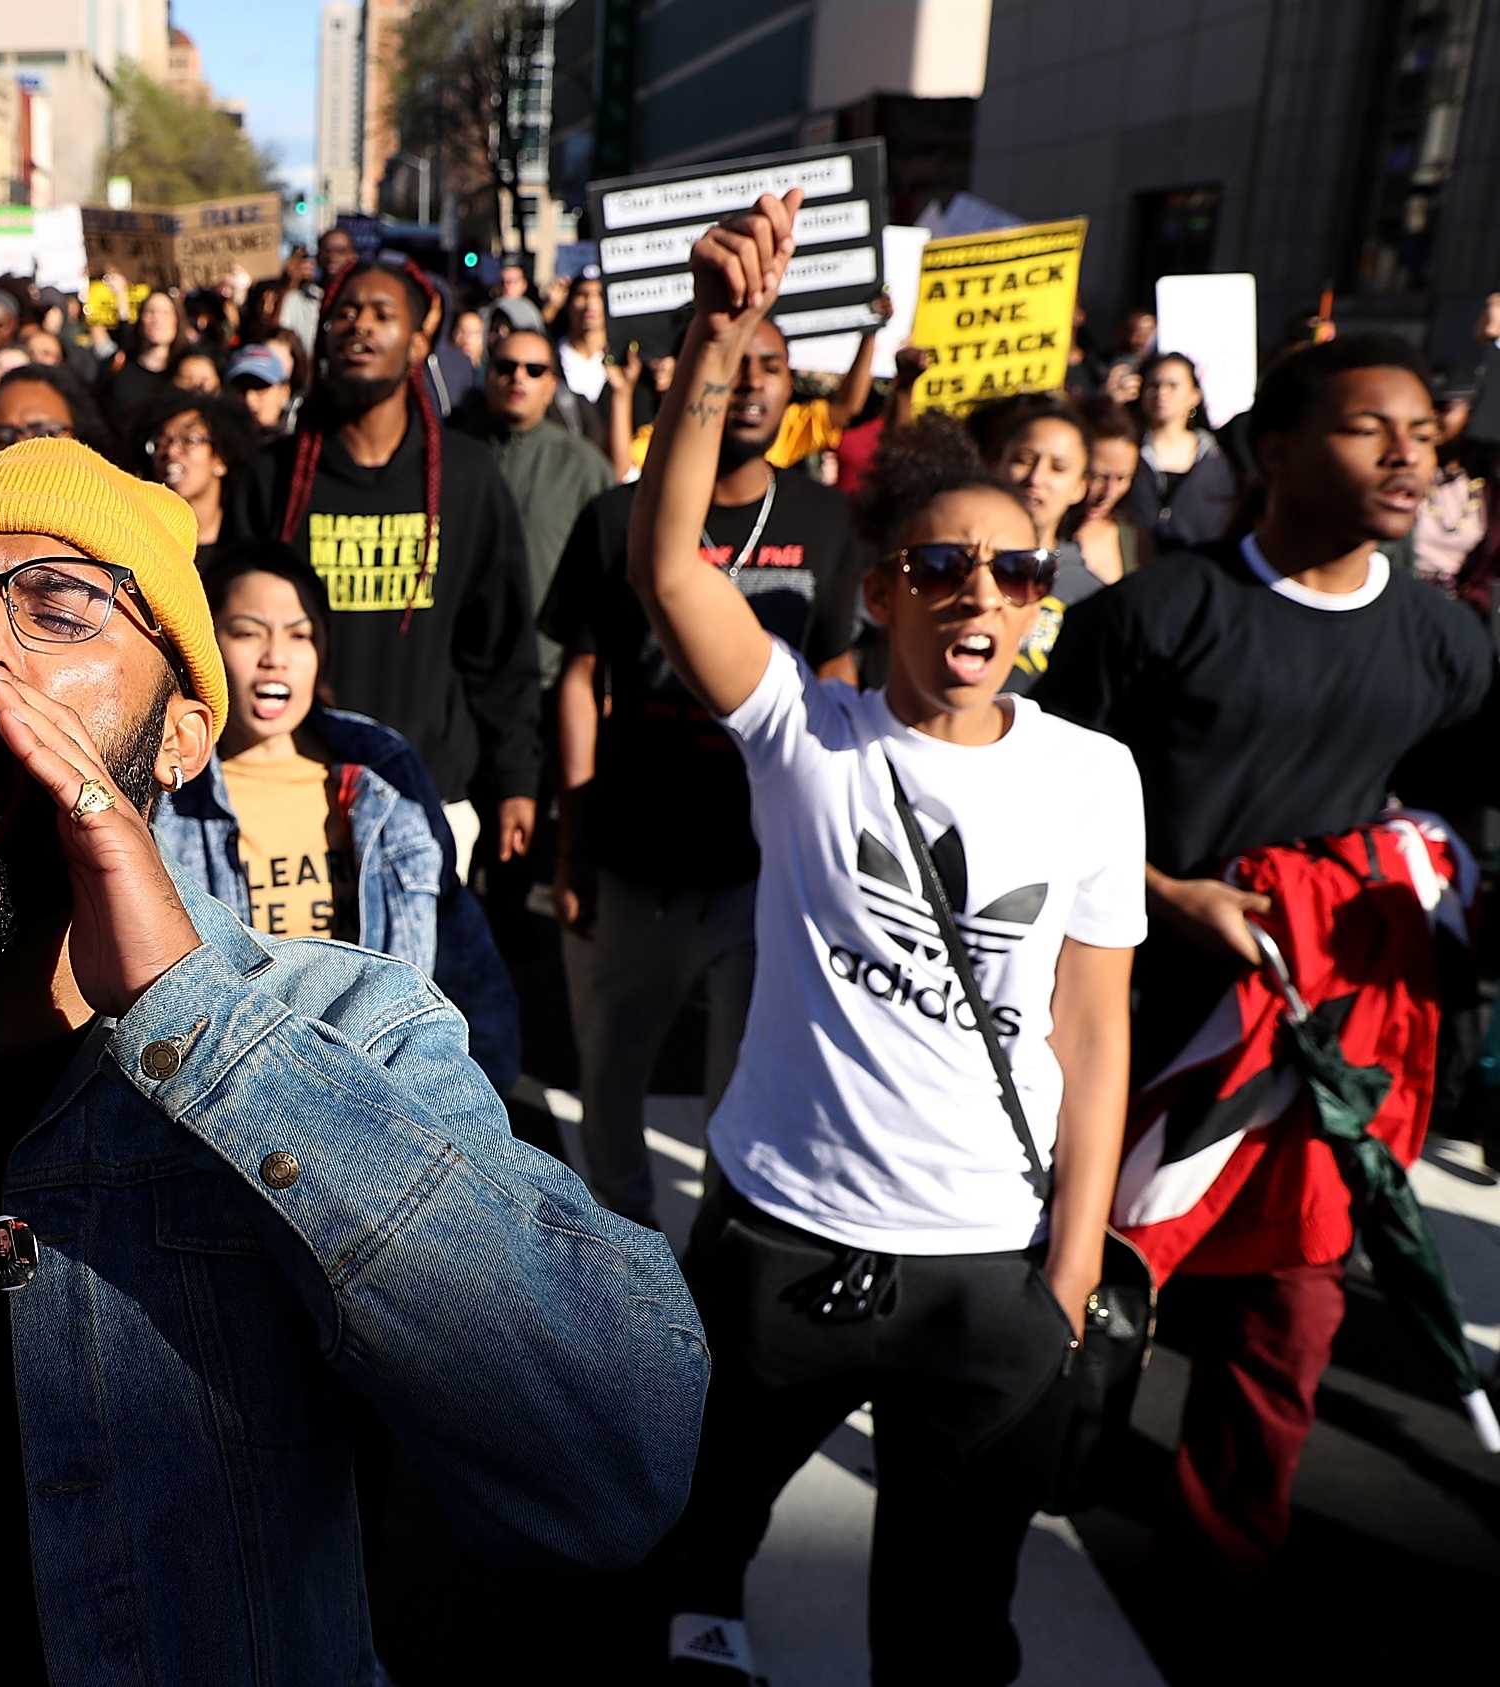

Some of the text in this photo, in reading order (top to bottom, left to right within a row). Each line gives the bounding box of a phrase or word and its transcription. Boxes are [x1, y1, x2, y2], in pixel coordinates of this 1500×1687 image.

[927, 262, 1066, 301] ATTACK
[956, 301, 1029, 329] ONE
[925, 330, 1057, 364] ATTACK
[926, 363, 1049, 396] US ALL!
[309, 513, 380, 538] BLACK
[829, 945, 1022, 1037] adidas
